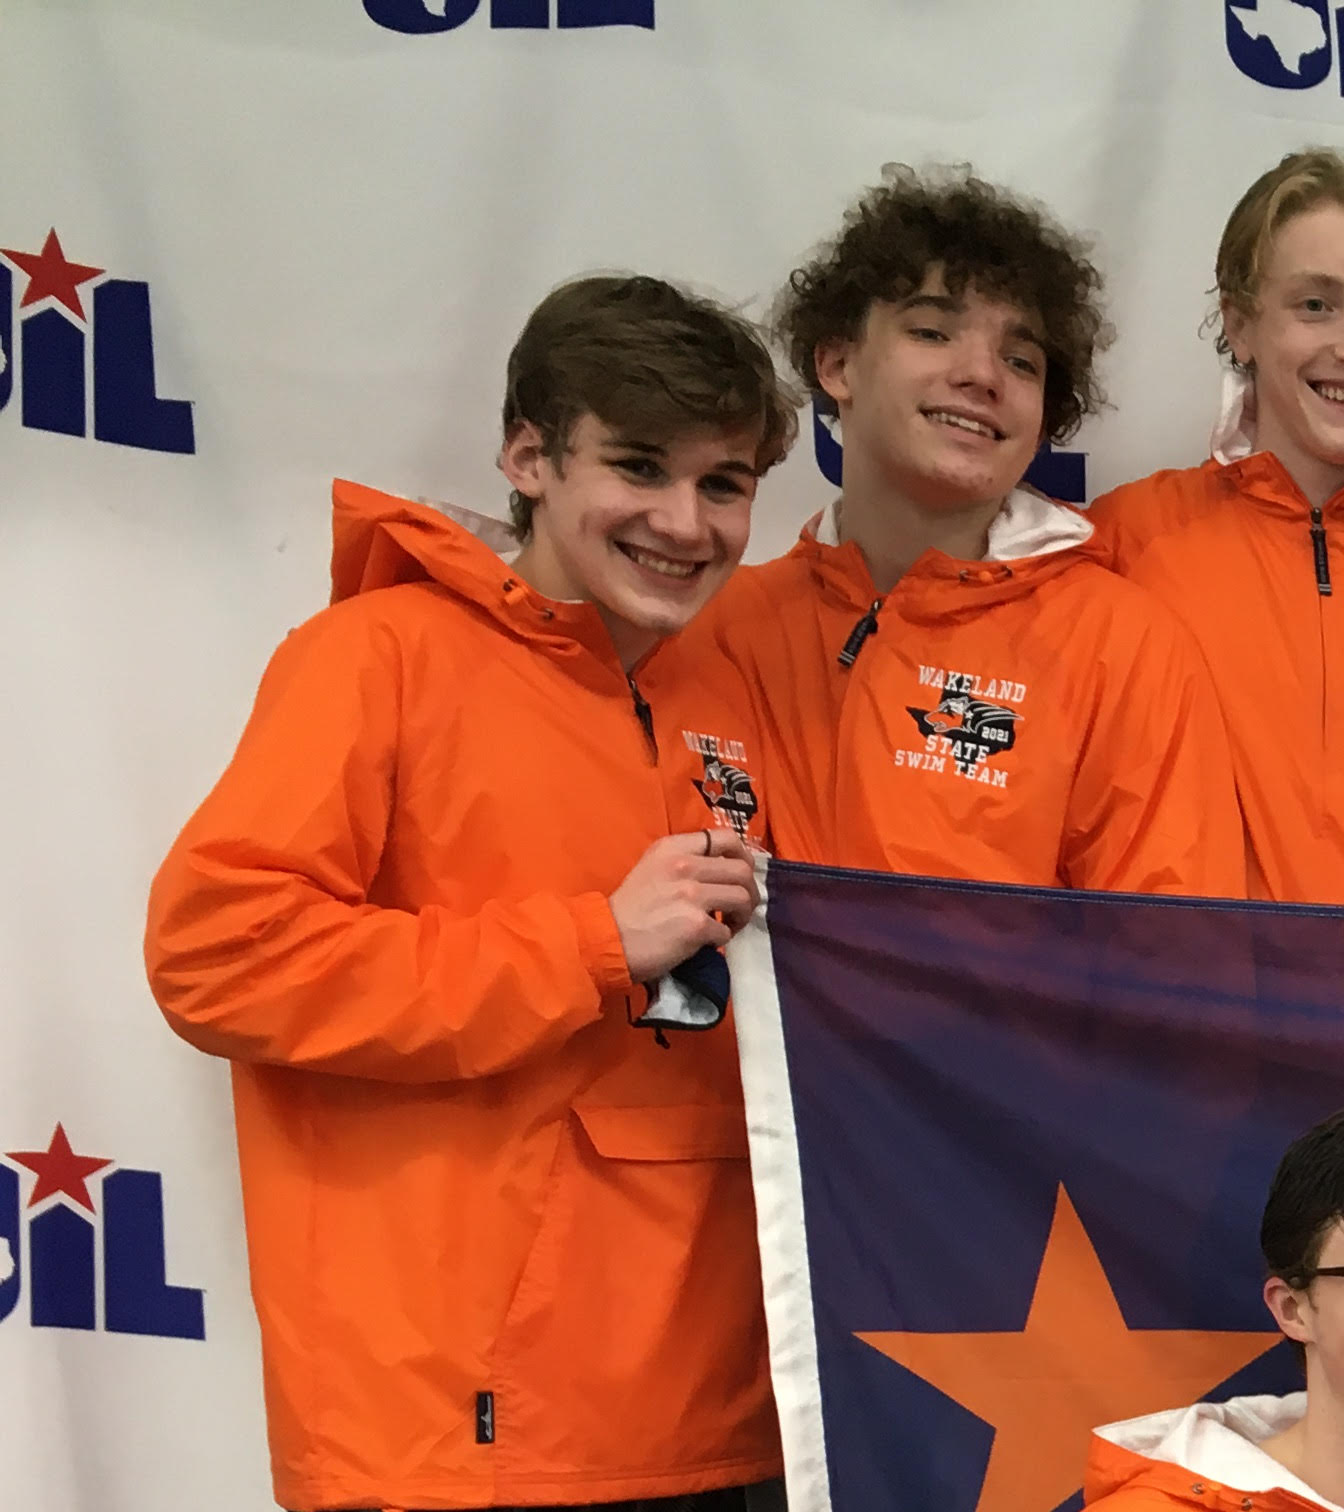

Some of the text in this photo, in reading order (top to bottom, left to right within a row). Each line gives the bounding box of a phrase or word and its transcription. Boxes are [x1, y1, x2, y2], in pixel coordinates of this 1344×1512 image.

[0, 226, 196, 455] IL
[918, 665, 1027, 703] WAKELAND
[925, 734, 990, 763] STATE
[981, 726, 1009, 743] 2021
[895, 749, 1008, 788] SWIM TEAM
[0, 1121, 206, 1341] IL
